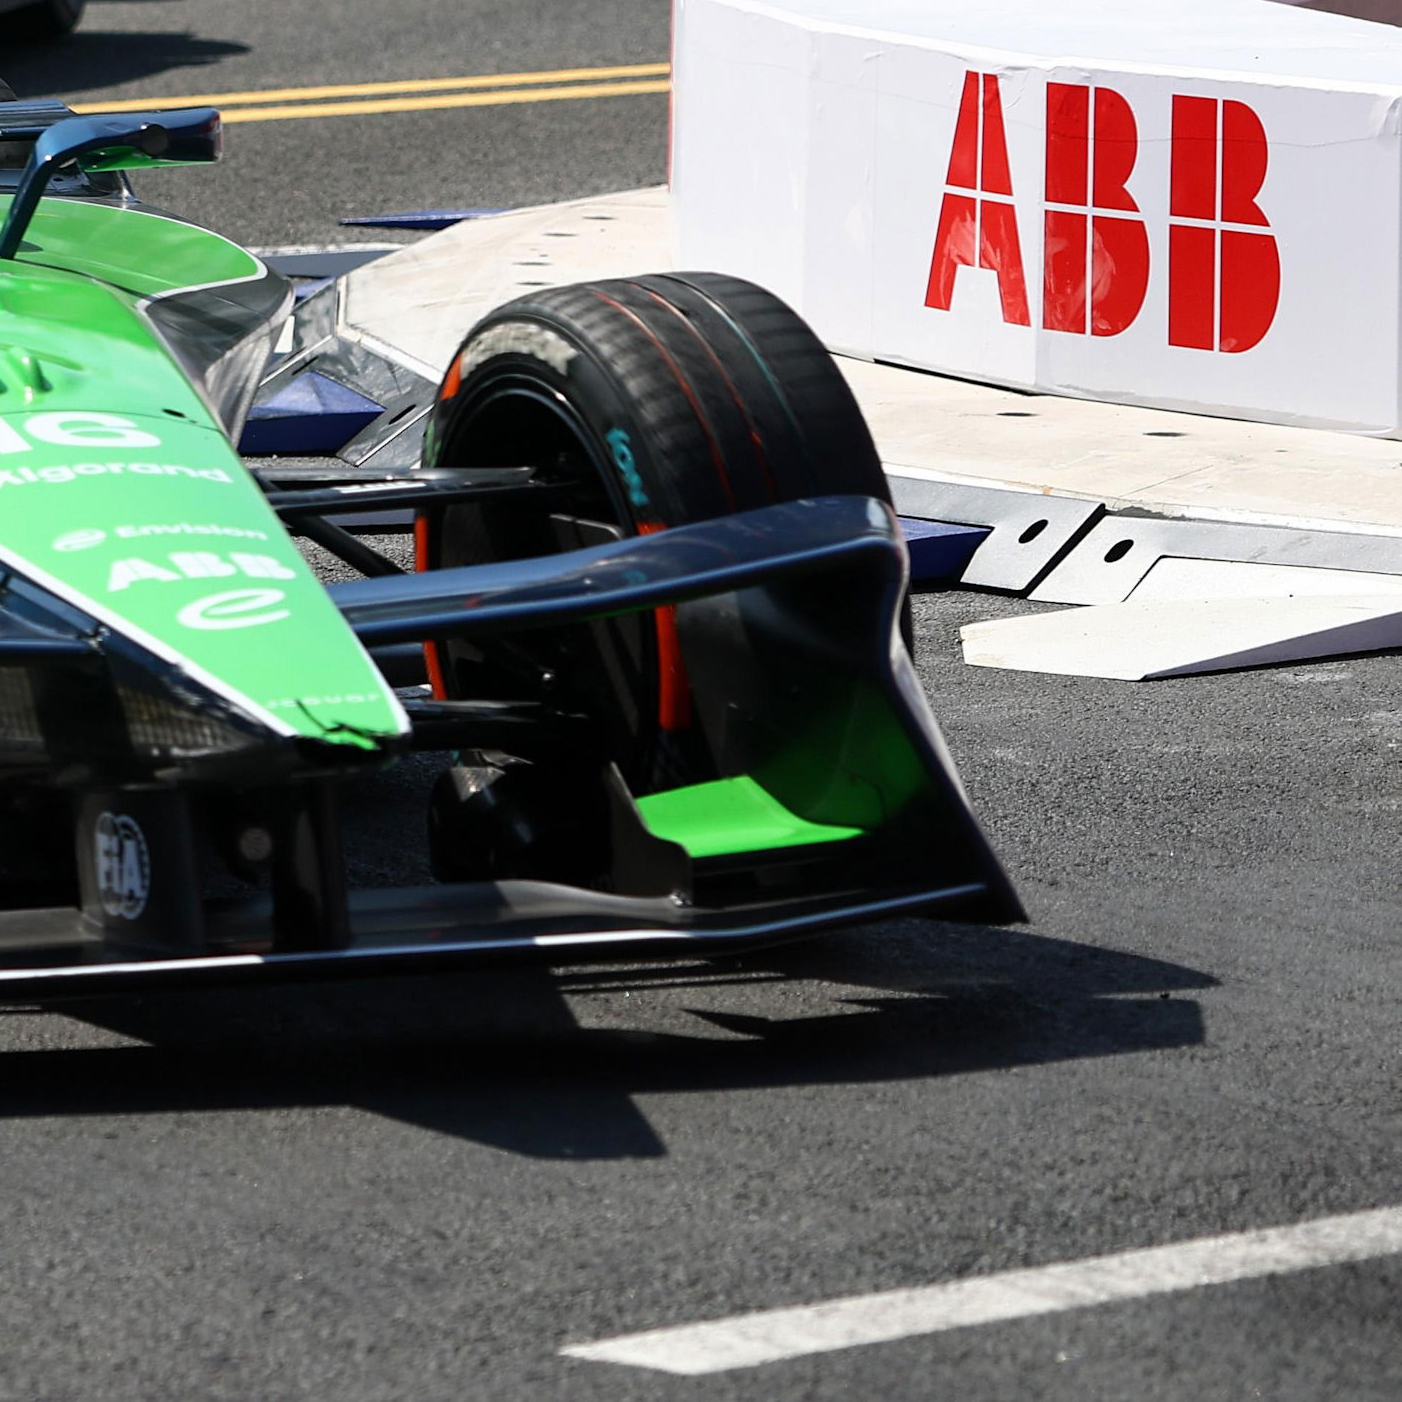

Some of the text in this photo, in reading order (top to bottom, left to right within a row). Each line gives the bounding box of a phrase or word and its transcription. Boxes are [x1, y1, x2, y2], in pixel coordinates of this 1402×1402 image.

[924, 70, 1282, 353] ABB
[115, 522, 268, 541] Envision
[108, 551, 296, 592] ABB
